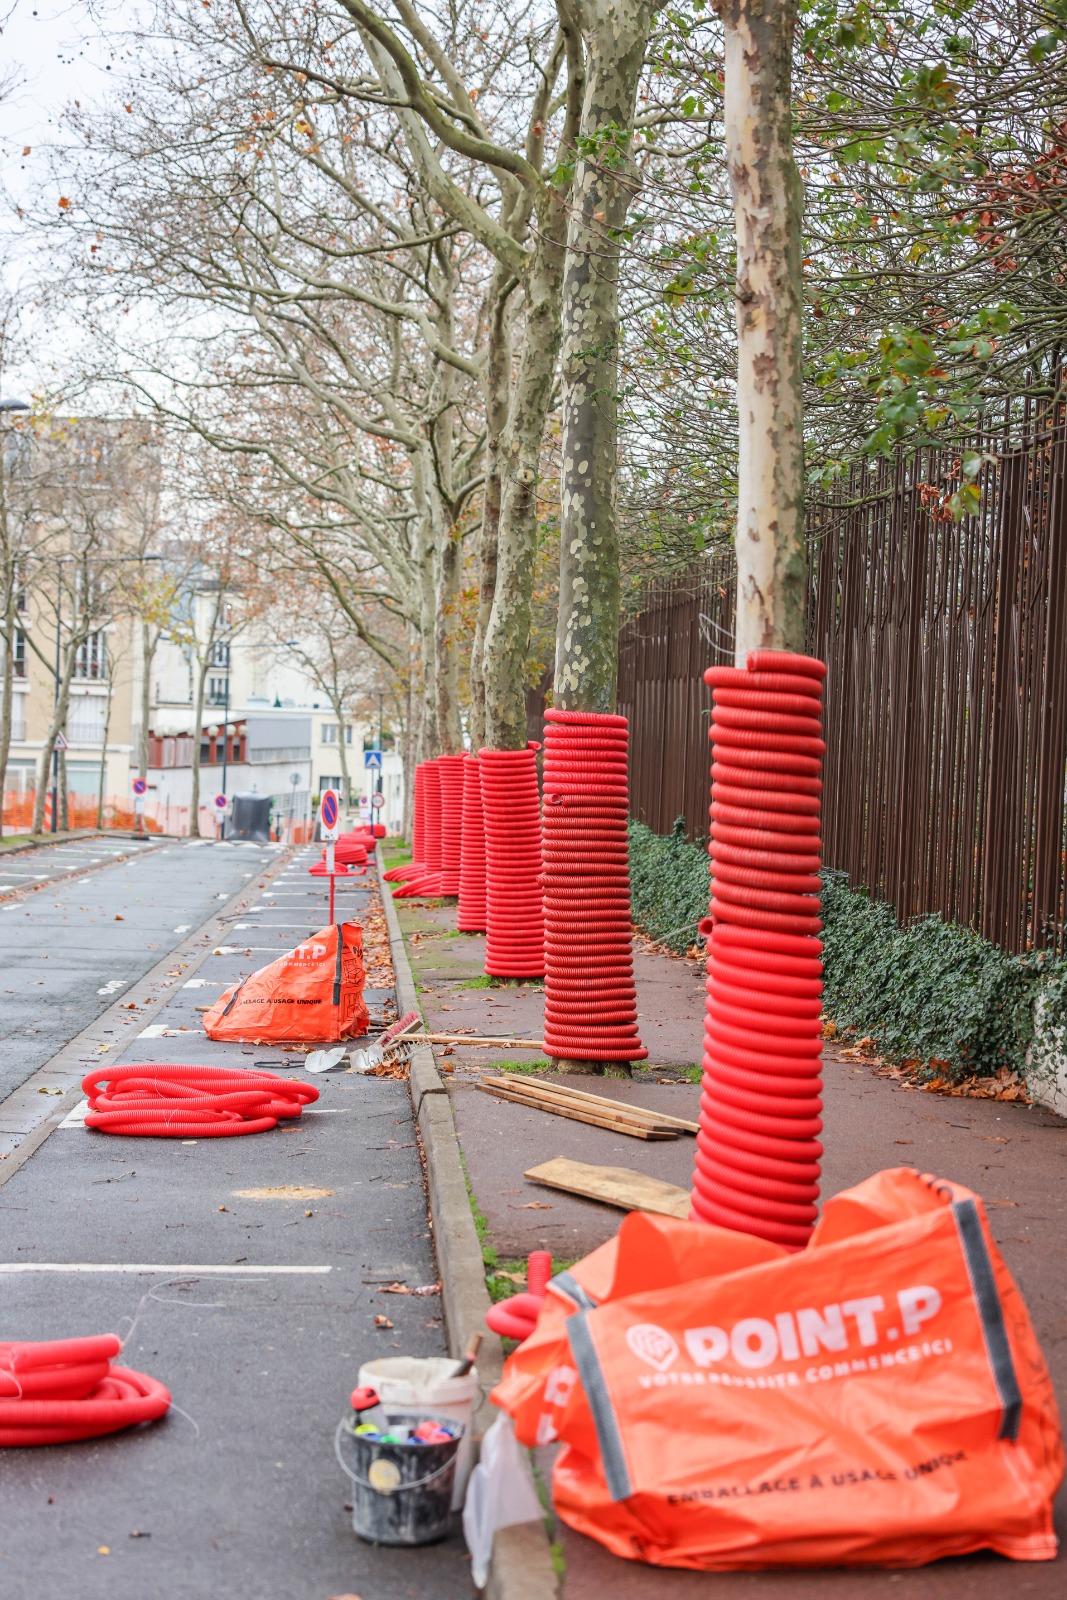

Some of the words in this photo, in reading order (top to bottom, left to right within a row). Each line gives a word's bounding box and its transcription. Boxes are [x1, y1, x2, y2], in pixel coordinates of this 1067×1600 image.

[684, 1285, 942, 1369] POINT.P
[804, 1345, 922, 1384] COMMENCE
[922, 1338, 954, 1358] ICI
[831, 1468, 898, 1487] USAGE
